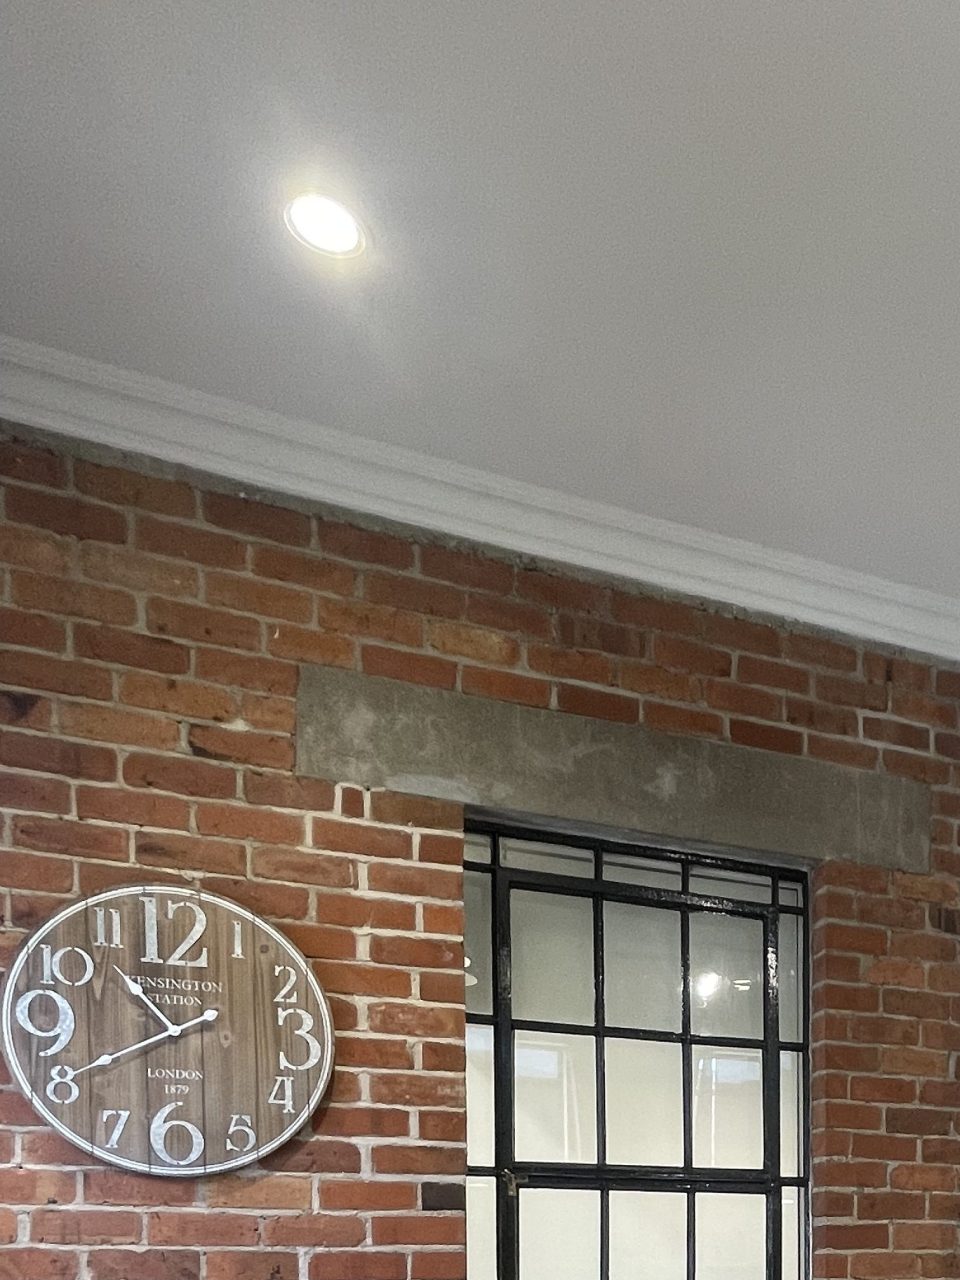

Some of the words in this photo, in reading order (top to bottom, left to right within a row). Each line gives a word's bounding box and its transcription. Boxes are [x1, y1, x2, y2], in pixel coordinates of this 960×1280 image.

[94, 907, 124, 949] 11
[139, 896, 208, 968] 12
[231, 920, 245, 959] 1
[39, 944, 95, 986] 10
[273, 965, 298, 1003] 2
[15, 989, 75, 1057] 9
[277, 1007, 321, 1071] 3
[46, 1065, 80, 1104] 8
[147, 1068, 203, 1080] LONDON
[164, 1084, 190, 1095] 1879
[268, 1076, 296, 1114] 4
[102, 1110, 131, 1149] 7
[150, 1101, 205, 1166] 6
[225, 1114, 257, 1152] 5
